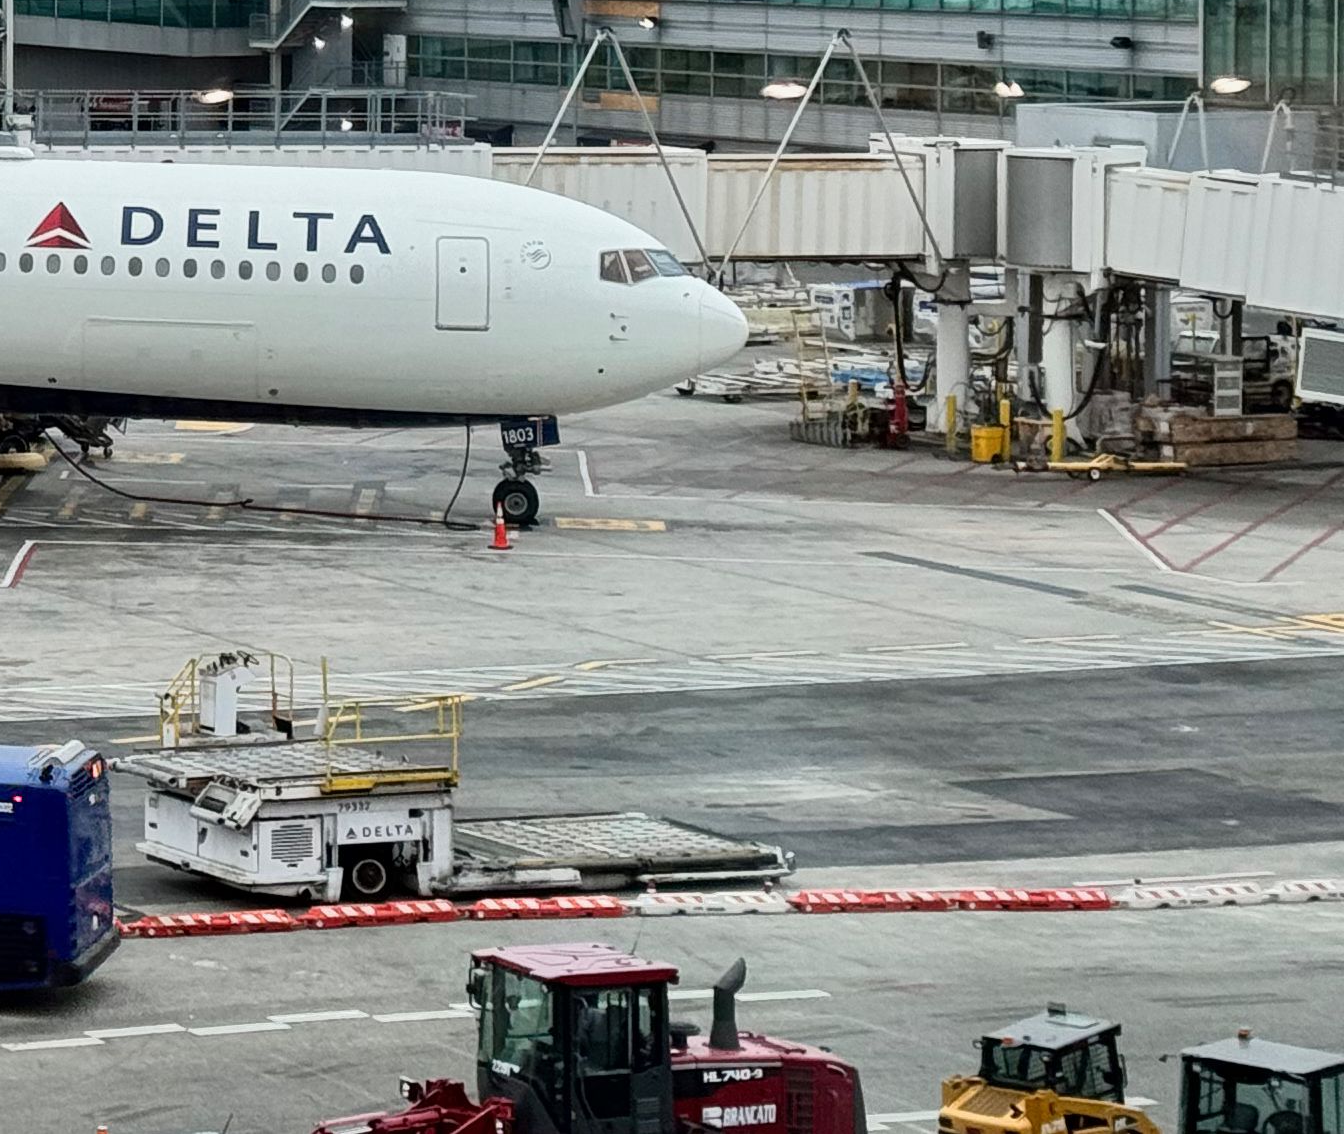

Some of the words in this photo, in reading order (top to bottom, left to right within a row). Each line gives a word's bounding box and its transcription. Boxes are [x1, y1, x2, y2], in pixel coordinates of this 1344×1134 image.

[121, 206, 392, 255] DELTA
[502, 426, 534, 444] 1803
[362, 825, 413, 837] DELTA
